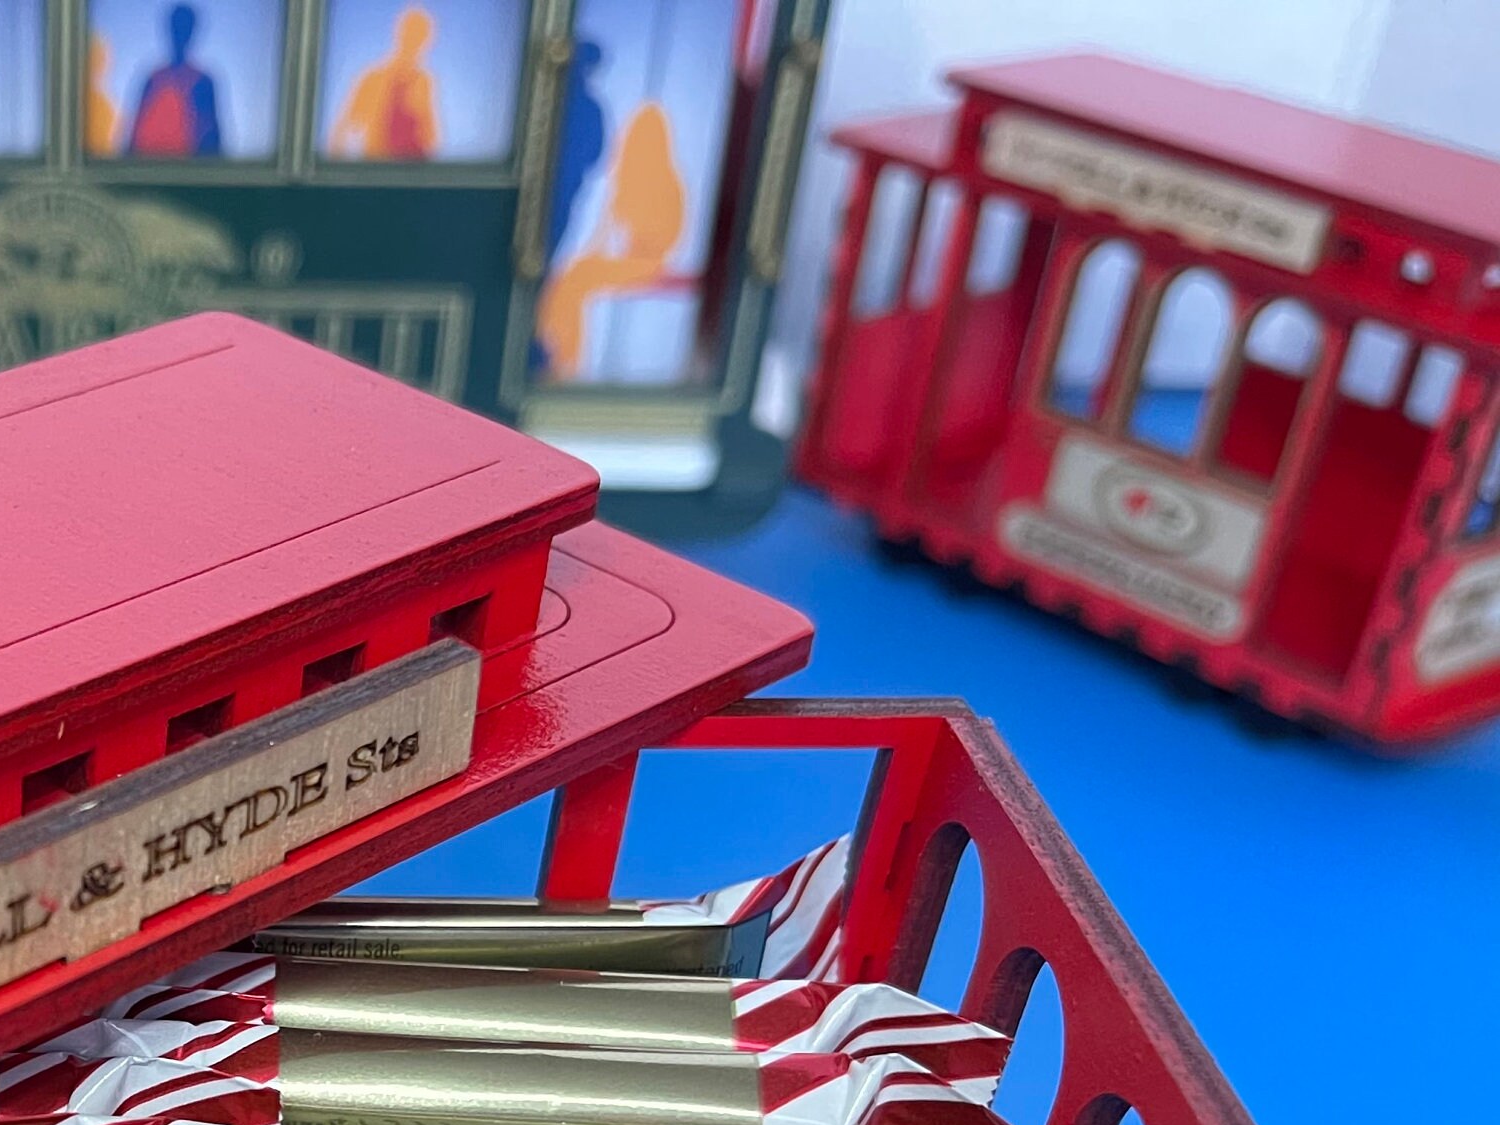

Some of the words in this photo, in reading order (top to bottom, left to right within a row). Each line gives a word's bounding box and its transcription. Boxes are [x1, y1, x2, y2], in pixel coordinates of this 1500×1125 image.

[68, 858, 126, 914] &
[141, 762, 329, 882] HYDE
[345, 730, 422, 792] Sts
[311, 937, 358, 958] retail
